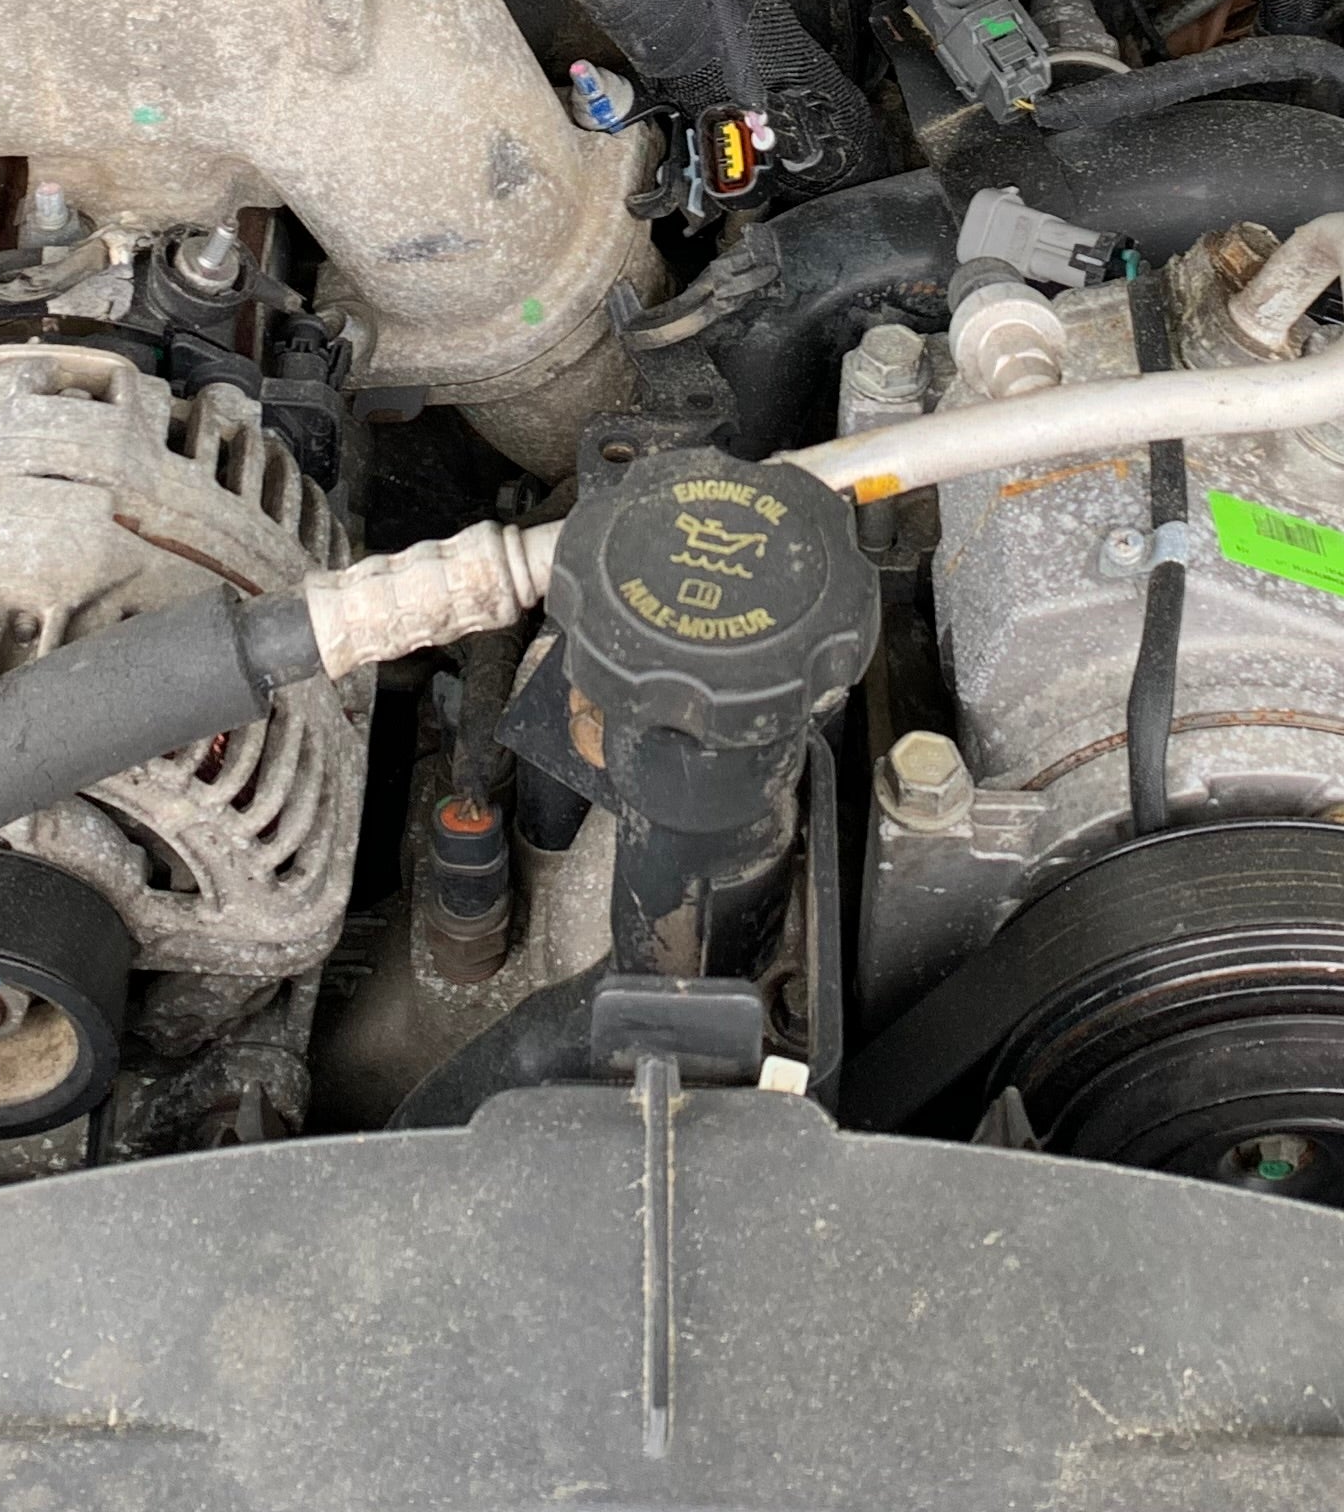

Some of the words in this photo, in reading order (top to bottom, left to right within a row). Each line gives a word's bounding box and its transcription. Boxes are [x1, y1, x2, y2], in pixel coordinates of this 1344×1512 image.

[673, 480, 757, 507] ENGINE
[754, 495, 788, 526] OIL
[619, 578, 778, 639] HUILE-MOTEUR
